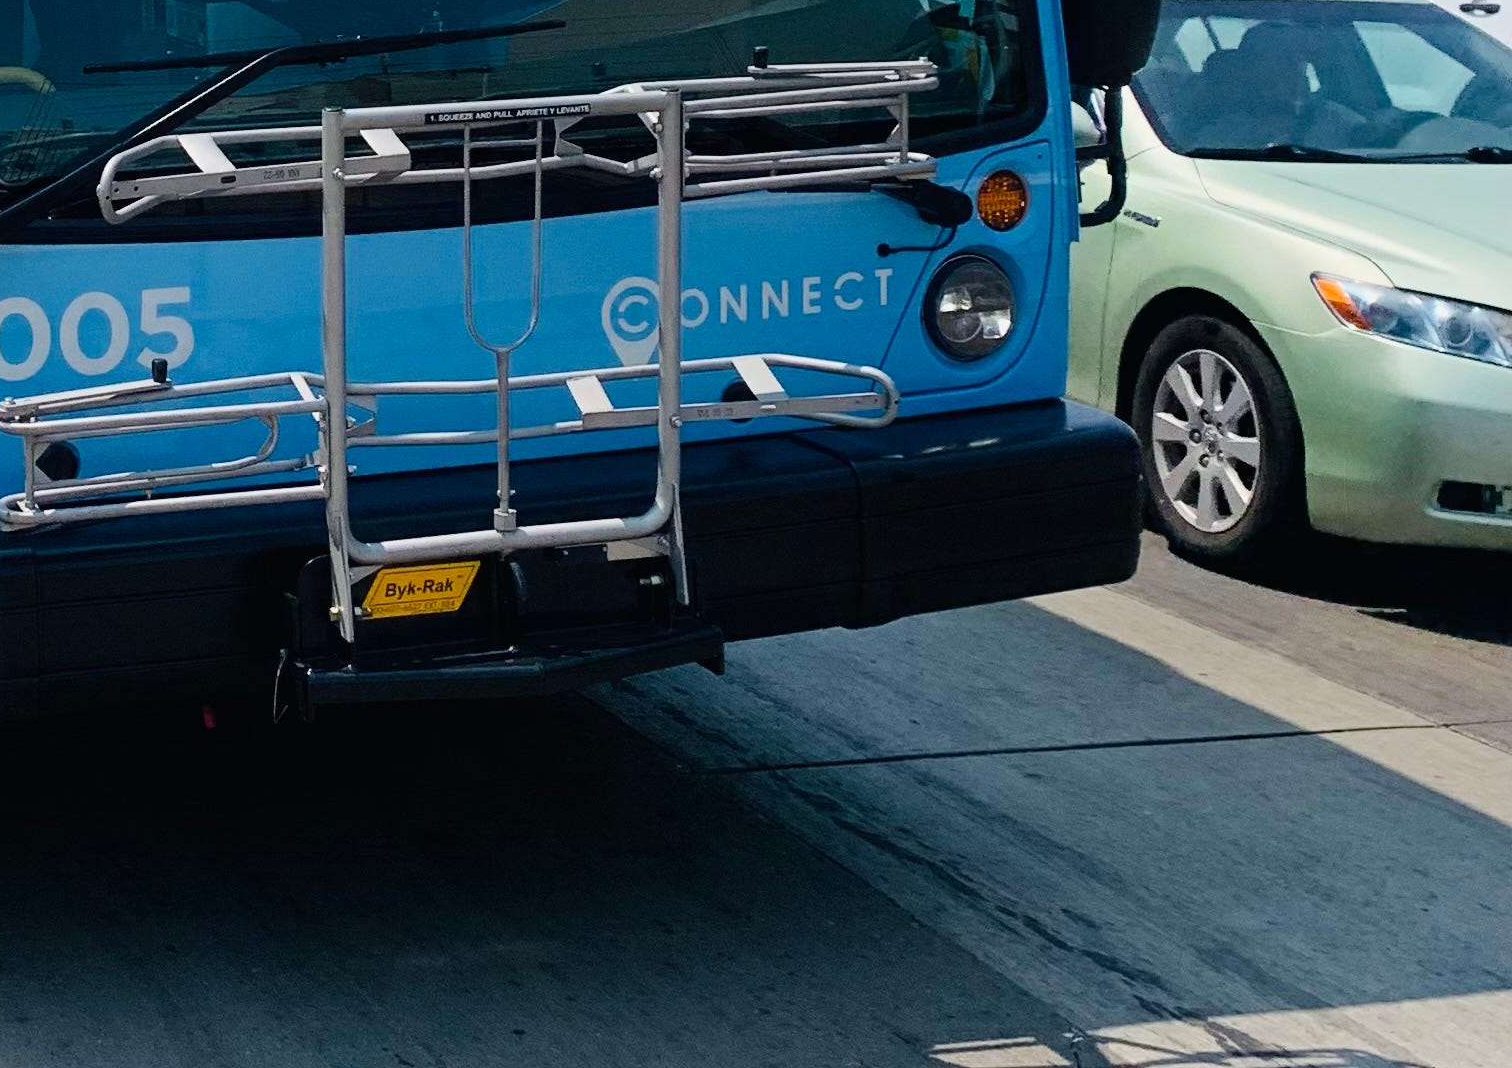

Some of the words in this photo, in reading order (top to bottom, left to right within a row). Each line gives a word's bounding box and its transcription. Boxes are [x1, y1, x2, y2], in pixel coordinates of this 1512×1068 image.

[438, 112, 474, 122] SQUEEZE
[475, 111, 492, 120] AND
[549, 107, 555, 115] Y
[556, 104, 590, 114] LEVANTE
[385, 577, 454, 600] Byk-Rak
